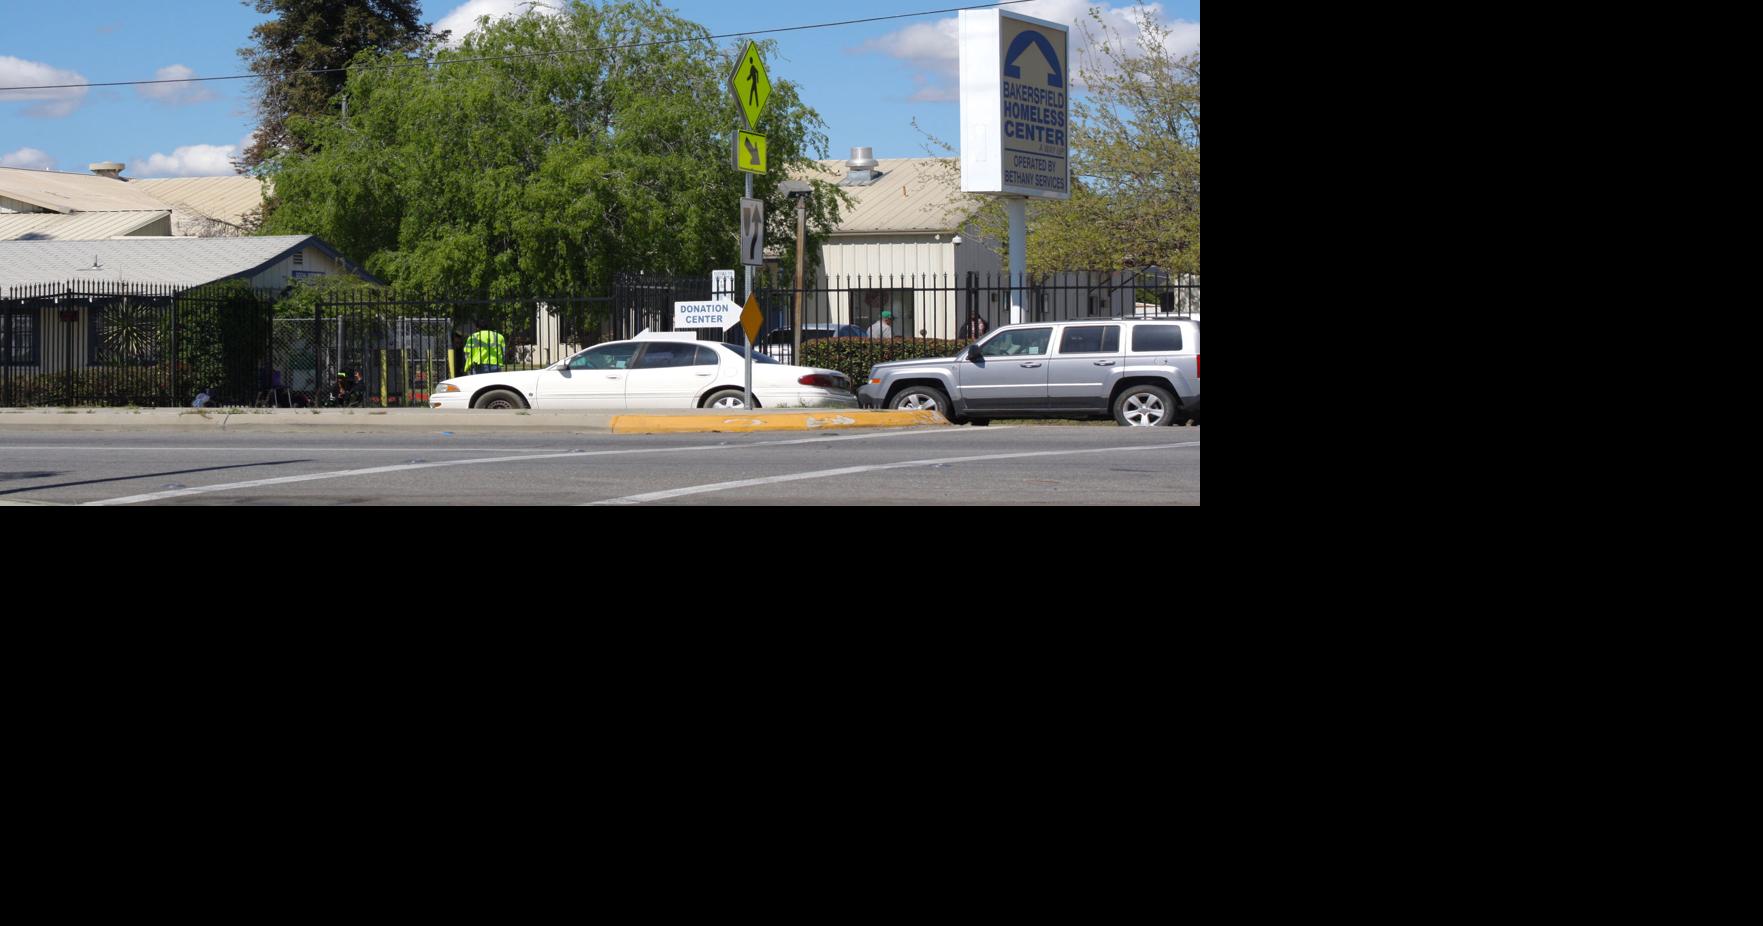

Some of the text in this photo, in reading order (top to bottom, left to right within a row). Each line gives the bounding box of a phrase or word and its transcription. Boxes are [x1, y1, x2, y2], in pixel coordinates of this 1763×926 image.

[1003, 81, 1065, 109] BAKERSFIELD
[1003, 101, 1065, 128] HOMELESS
[1004, 120, 1065, 146] CENTER
[1013, 155, 1057, 172] OPERATED BY
[1004, 170, 1065, 189] BETHANY SERVICES
[680, 304, 729, 313] DONATION
[685, 315, 723, 323] CENTER
